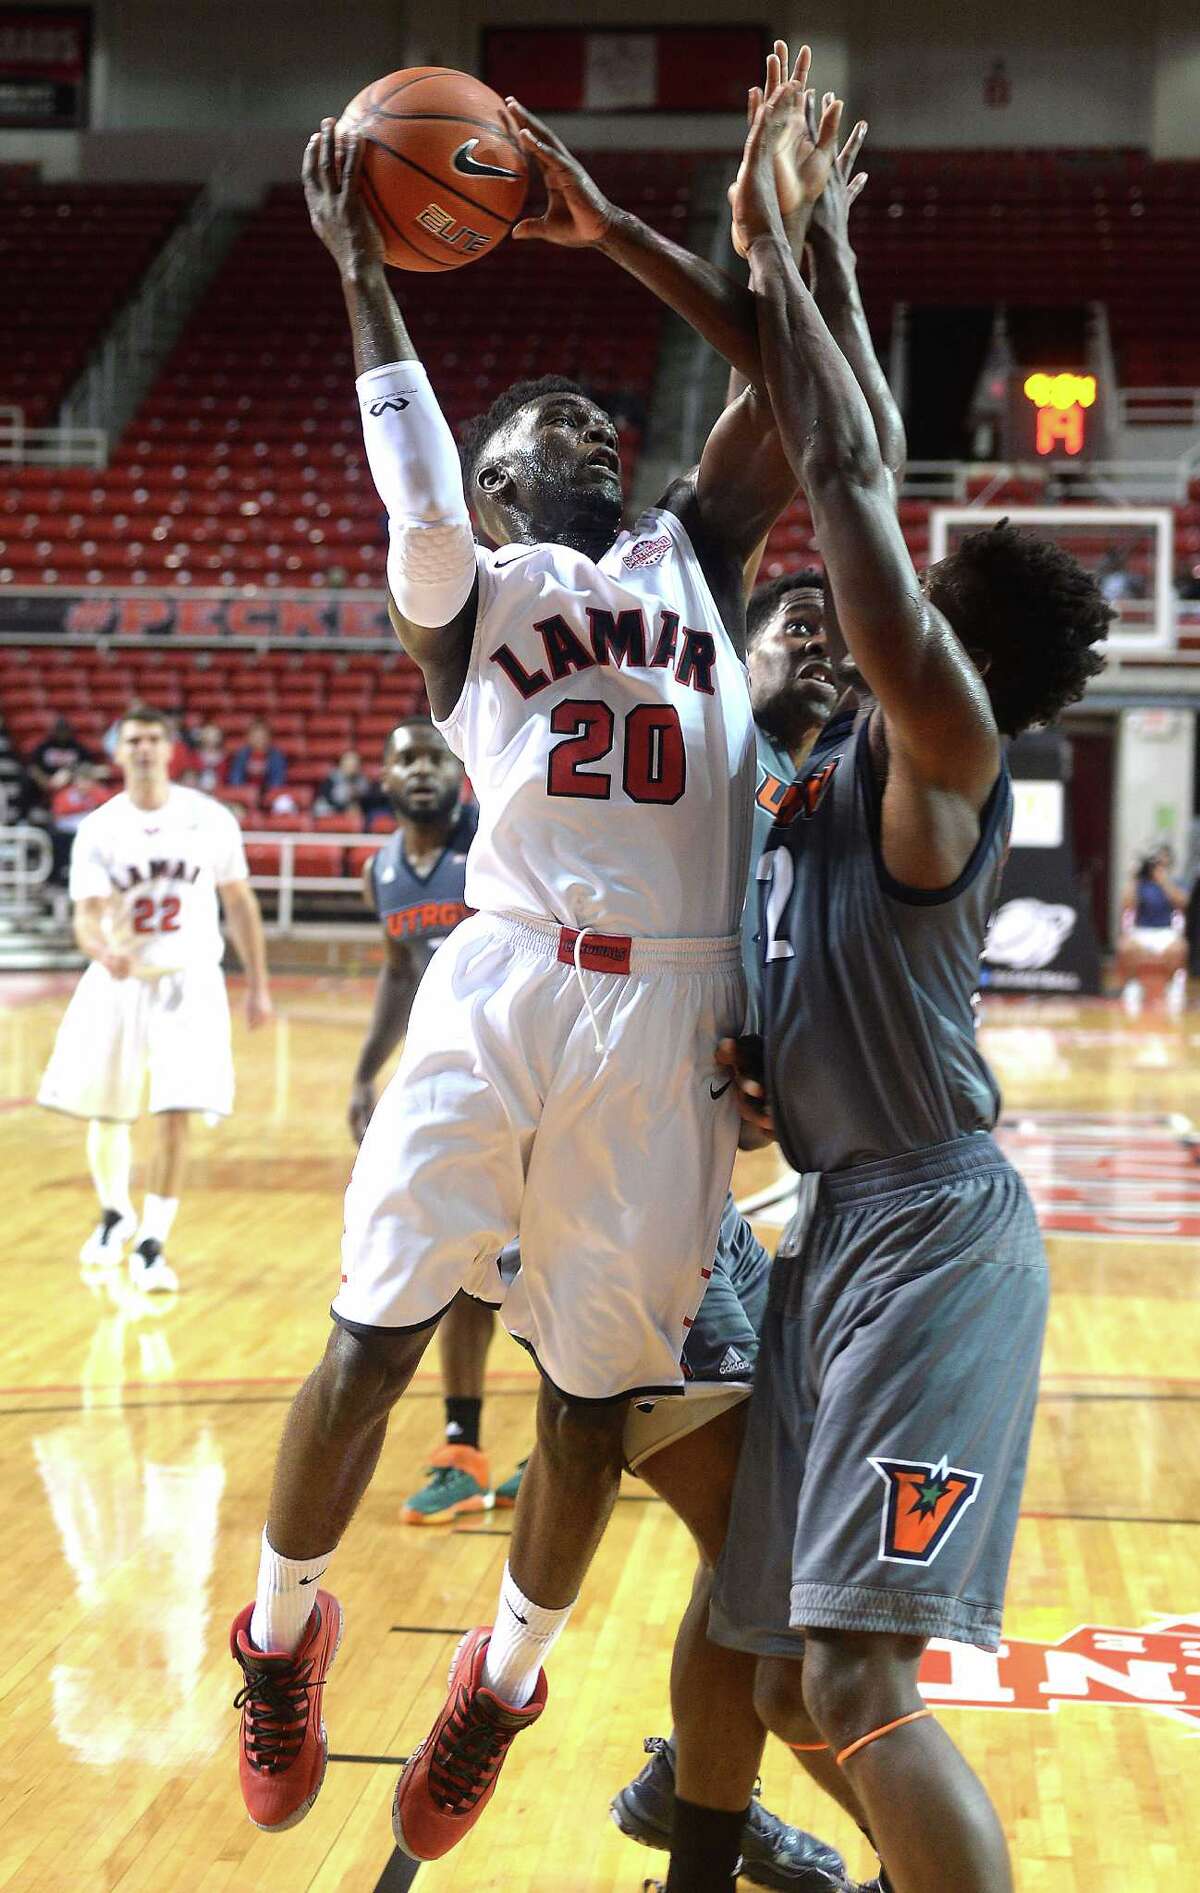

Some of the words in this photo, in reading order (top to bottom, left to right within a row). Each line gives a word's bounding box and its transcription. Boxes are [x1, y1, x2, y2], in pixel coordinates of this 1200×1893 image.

[415, 202, 493, 254] ELITE
[489, 606, 717, 700] LAMAR
[546, 697, 687, 806] 20
[132, 895, 183, 935] 22
[385, 901, 480, 939] UTRG
